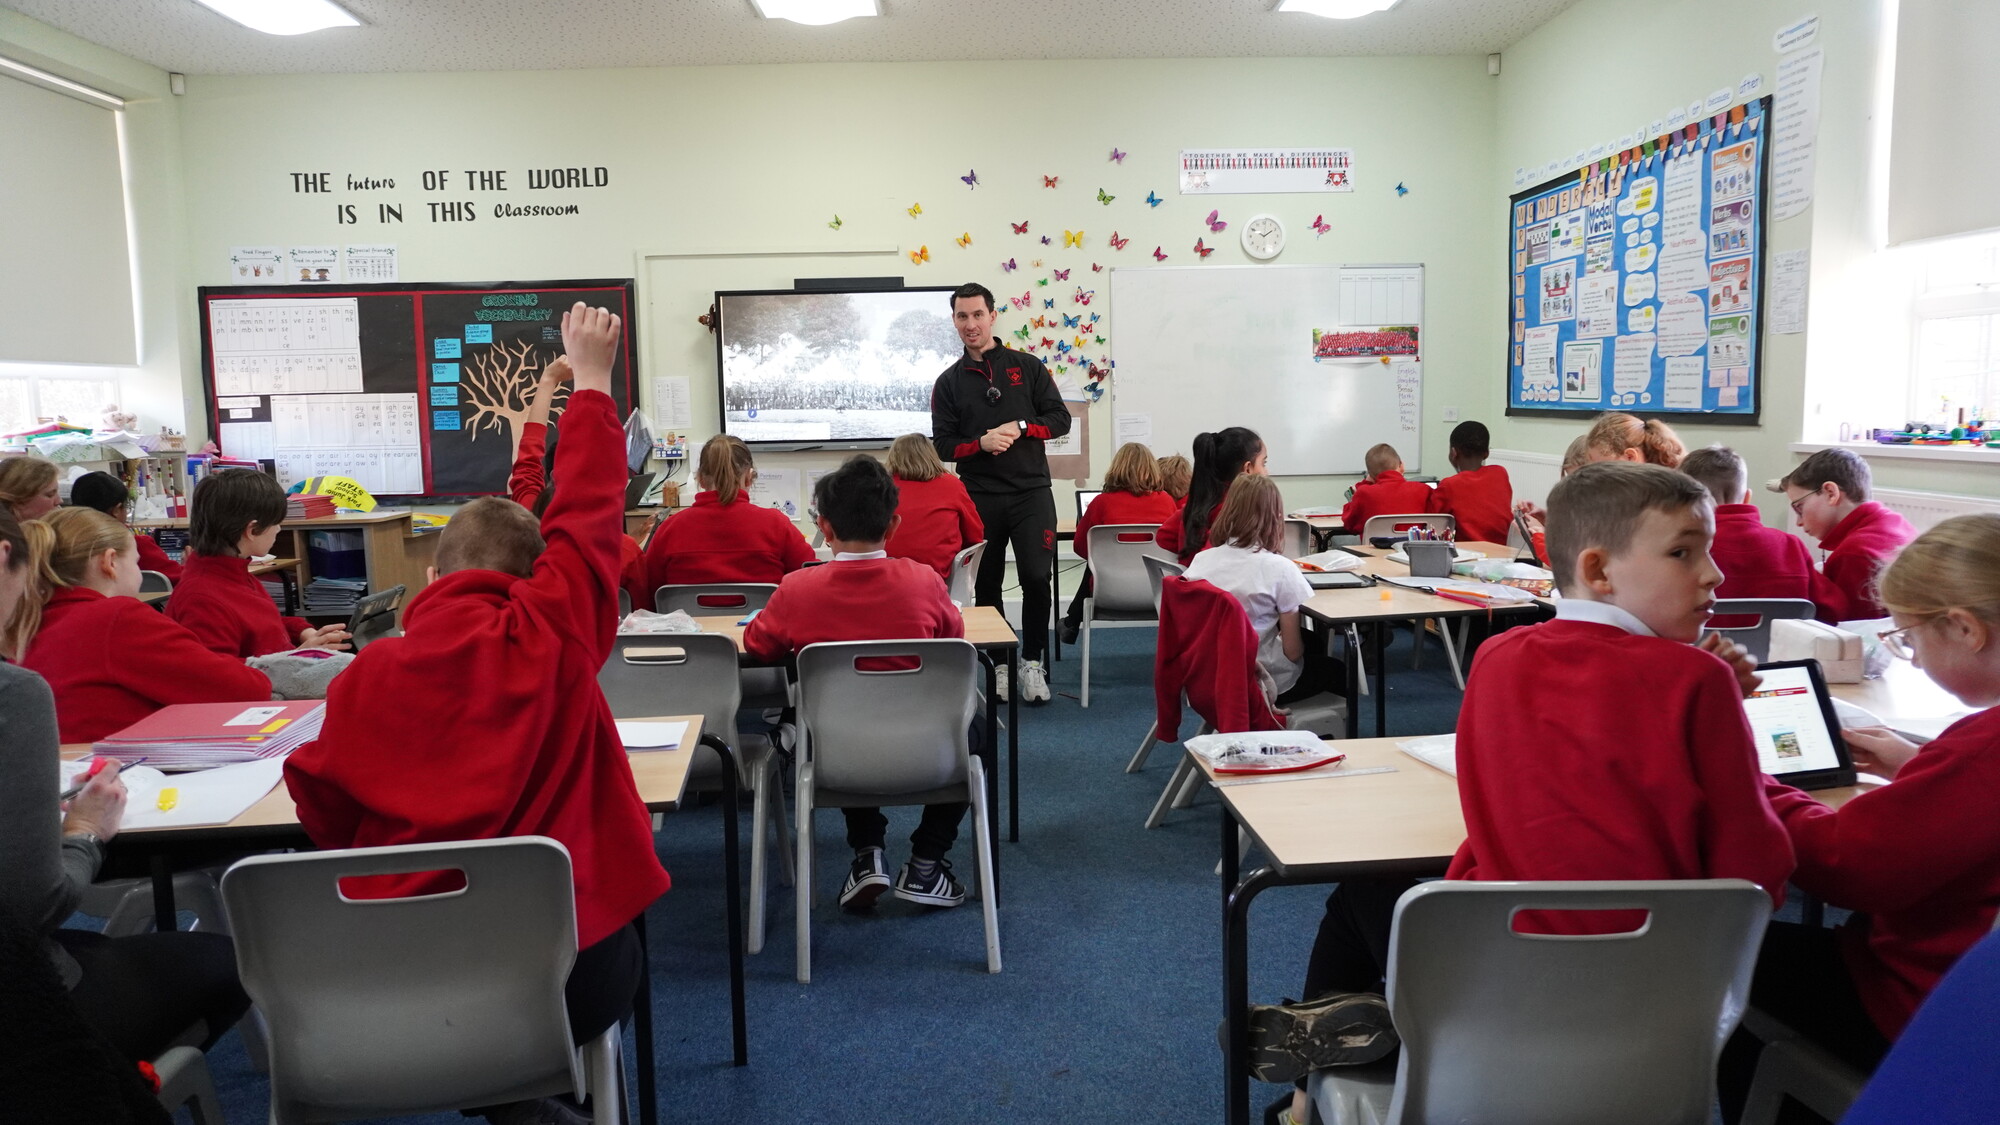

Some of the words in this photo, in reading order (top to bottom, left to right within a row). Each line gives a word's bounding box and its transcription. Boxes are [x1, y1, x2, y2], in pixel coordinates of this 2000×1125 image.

[1738, 78, 1760, 95] after
[1707, 92, 1730, 106] because
[1668, 112, 1686, 126] before
[1652, 123, 1662, 133] but
[1715, 152, 1739, 166] Nouns
[290, 172, 331, 193] THE
[347, 174, 396, 191] future
[422, 170, 450, 191] OF
[465, 170, 508, 191] THE
[528, 167, 609, 189] WORLD
[338, 204, 357, 224] IS
[379, 204, 403, 223] IN
[427, 202, 476, 223] THIS
[494, 203, 579, 218] Classroom
[1589, 200, 1613, 218] Modal
[1714, 208, 1731, 220] Verbs
[1589, 218, 1612, 234] Verbs
[1712, 263, 1746, 279] Adjectives
[482, 294, 538, 306] GROWING
[474, 309, 552, 321] VOCABULARY
[1712, 321, 1733, 331] Adverbs
[325, 489, 346, 500] Junior
[335, 486, 358, 499] School
[336, 481, 364, 496] STAFF
